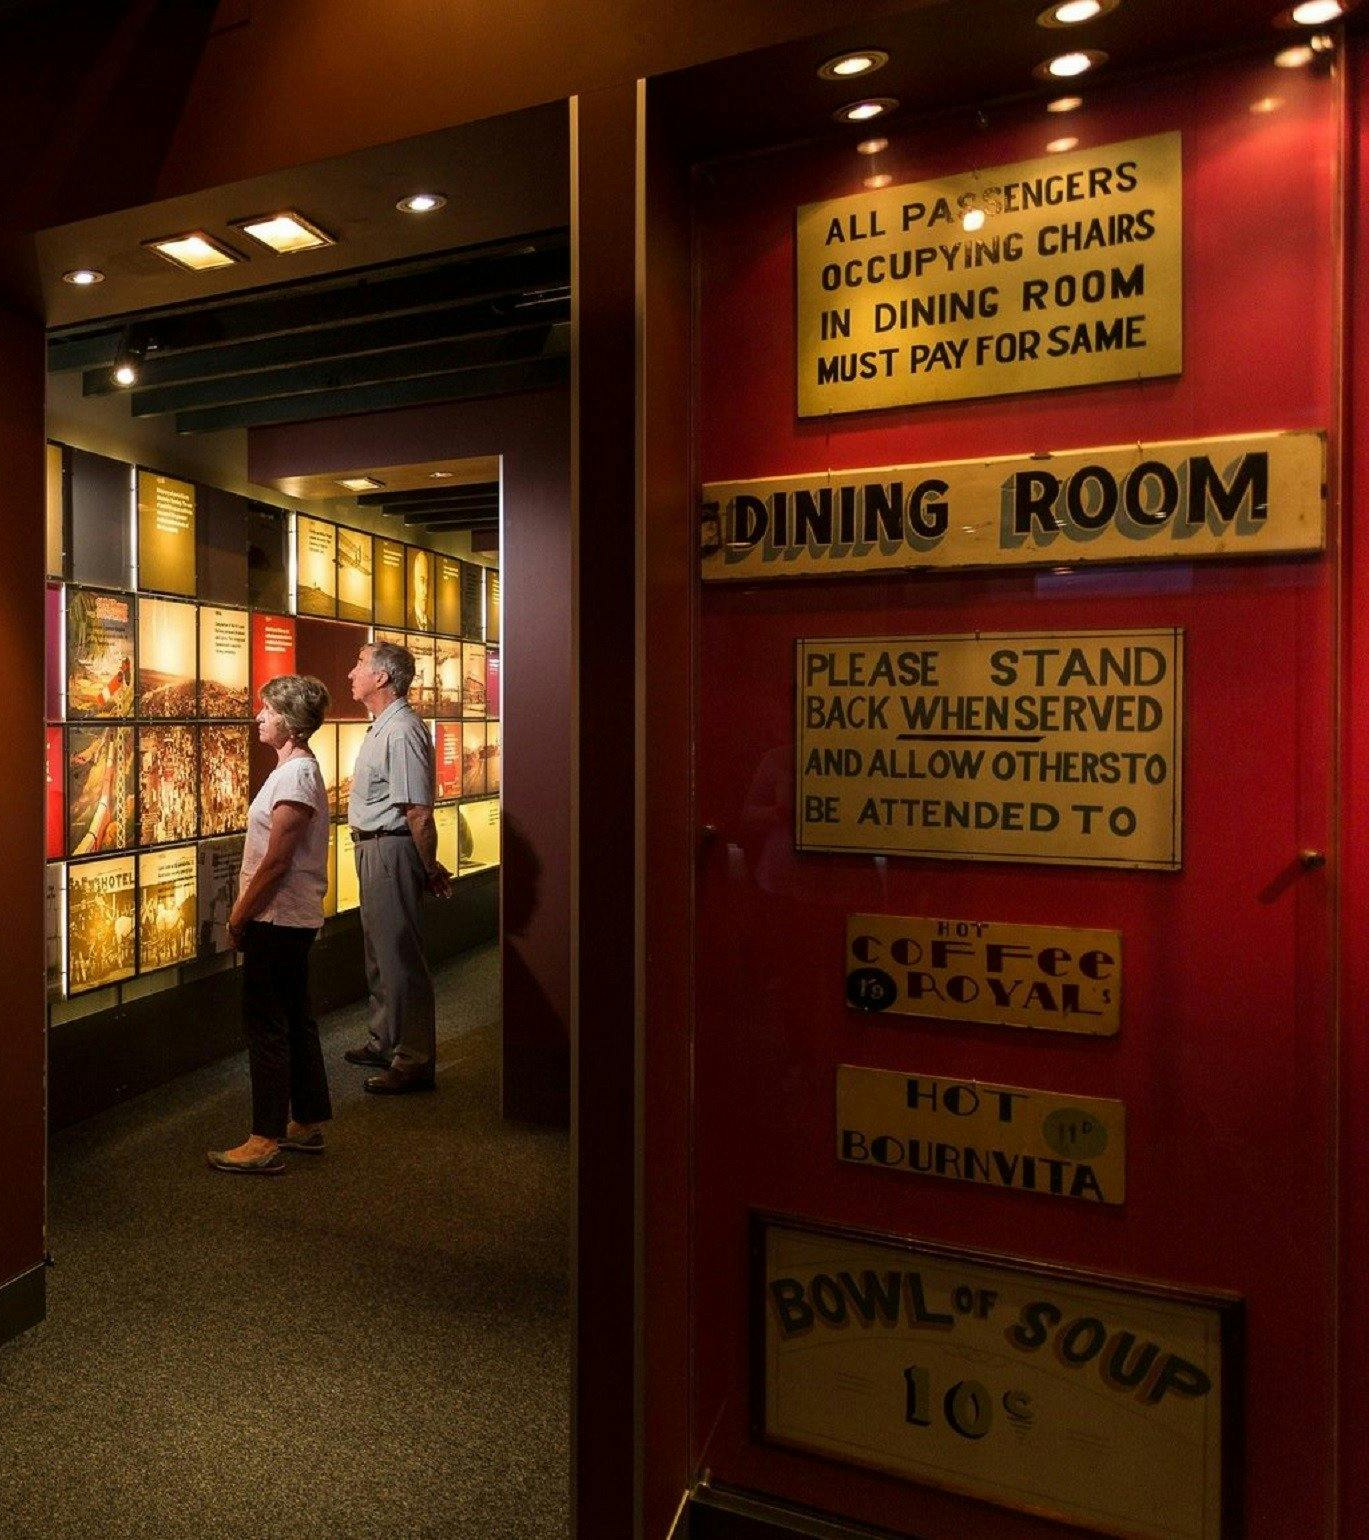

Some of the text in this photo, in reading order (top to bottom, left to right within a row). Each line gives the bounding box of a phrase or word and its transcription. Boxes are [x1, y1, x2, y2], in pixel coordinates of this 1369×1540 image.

[825, 161, 1138, 247] ALL PASSENGERS
[821, 209, 1156, 292] OCCUPYING CHAIRS
[820, 263, 1146, 341] IN DINING ROOM
[817, 315, 1147, 386] MUST PAY FOR SAME
[727, 450, 1270, 558] DINING ROOM
[806, 646, 1167, 688] PLEASE STAND
[806, 695, 1163, 733] BACK WHEN SERVED
[804, 748, 1167, 786] AND ALLOW OTHERS TO
[804, 796, 1138, 837] BE ATTENDED TO
[937, 920, 989, 938] HOT
[906, 1078, 1030, 1124] HOT
[842, 1129, 1106, 1202] BOURNVITA
[768, 1269, 1212, 1406] BOWL OF SOUP
